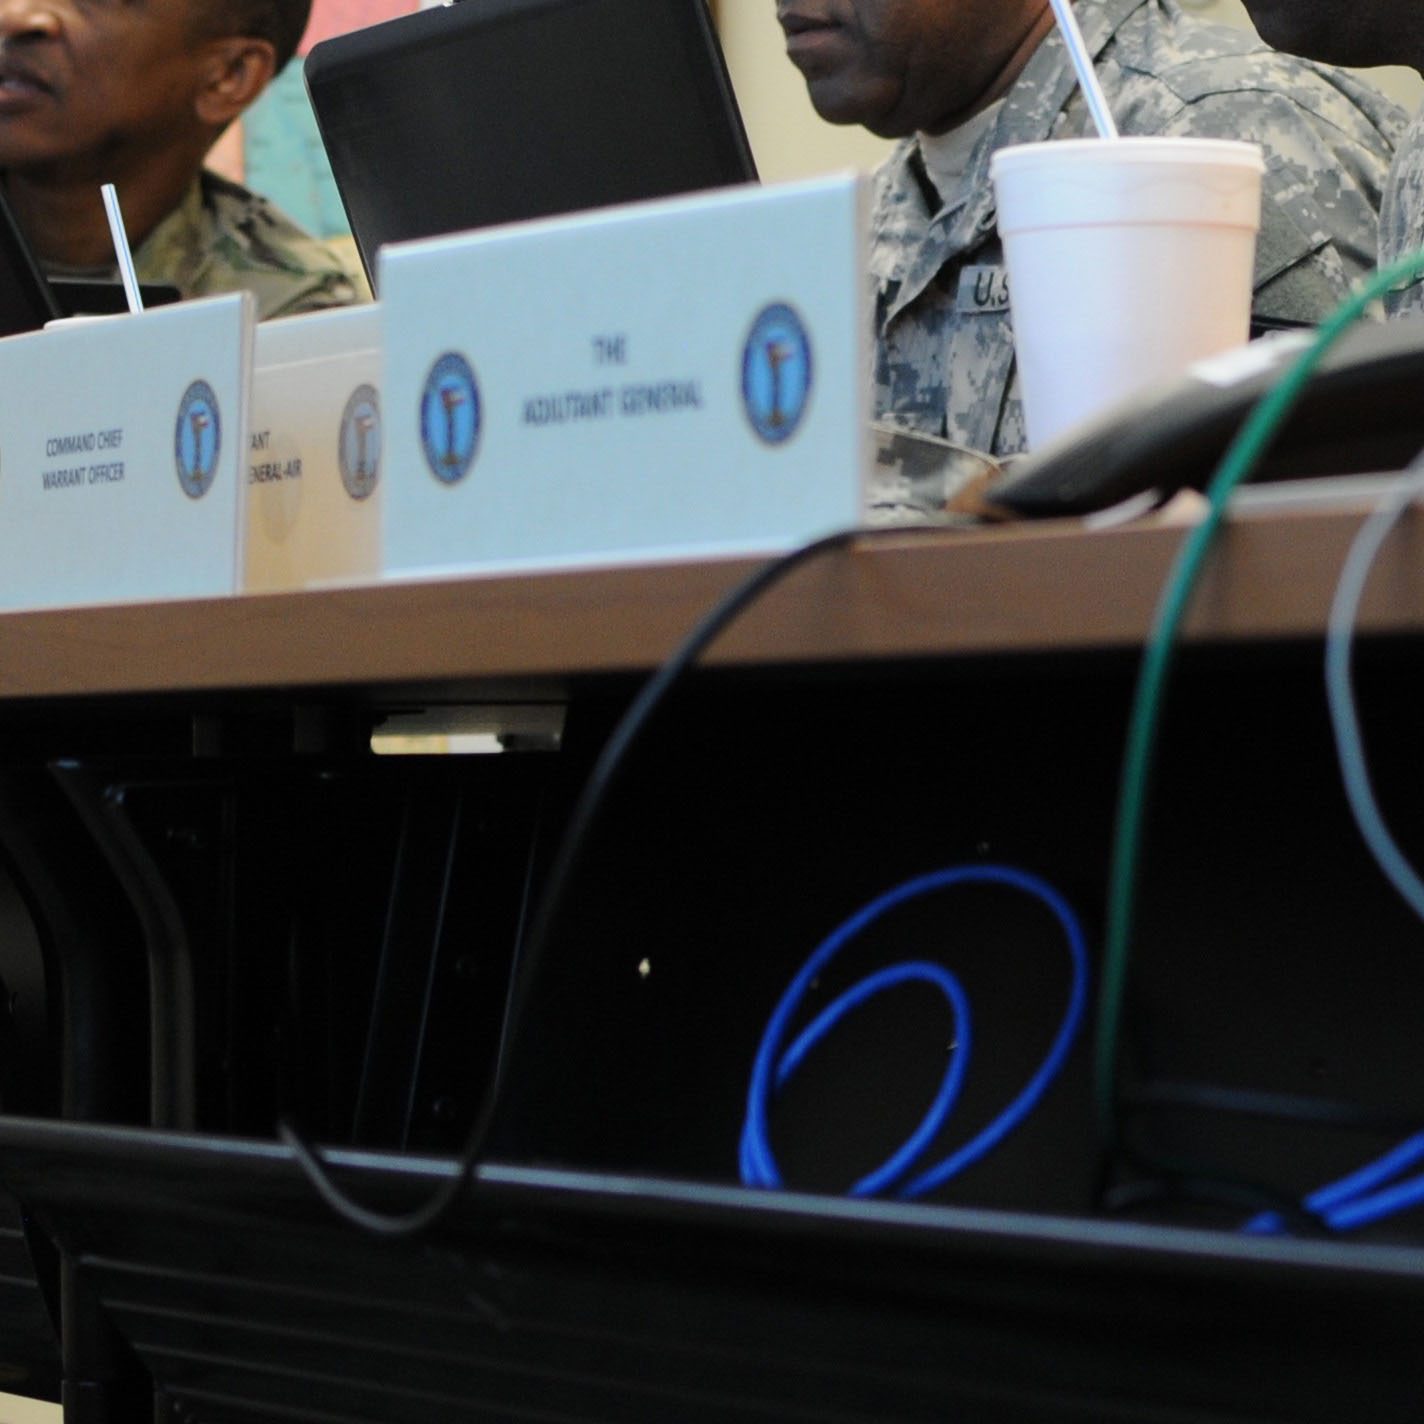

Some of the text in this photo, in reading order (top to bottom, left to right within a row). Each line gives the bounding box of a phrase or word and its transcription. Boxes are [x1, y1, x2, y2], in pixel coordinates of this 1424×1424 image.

[591, 333, 627, 366] THE
[522, 378, 703, 425] ADJUTANT GENERAL
[46, 428, 123, 457] COMMAND CHIEF
[42, 461, 125, 491] WARRANT OFFICER
